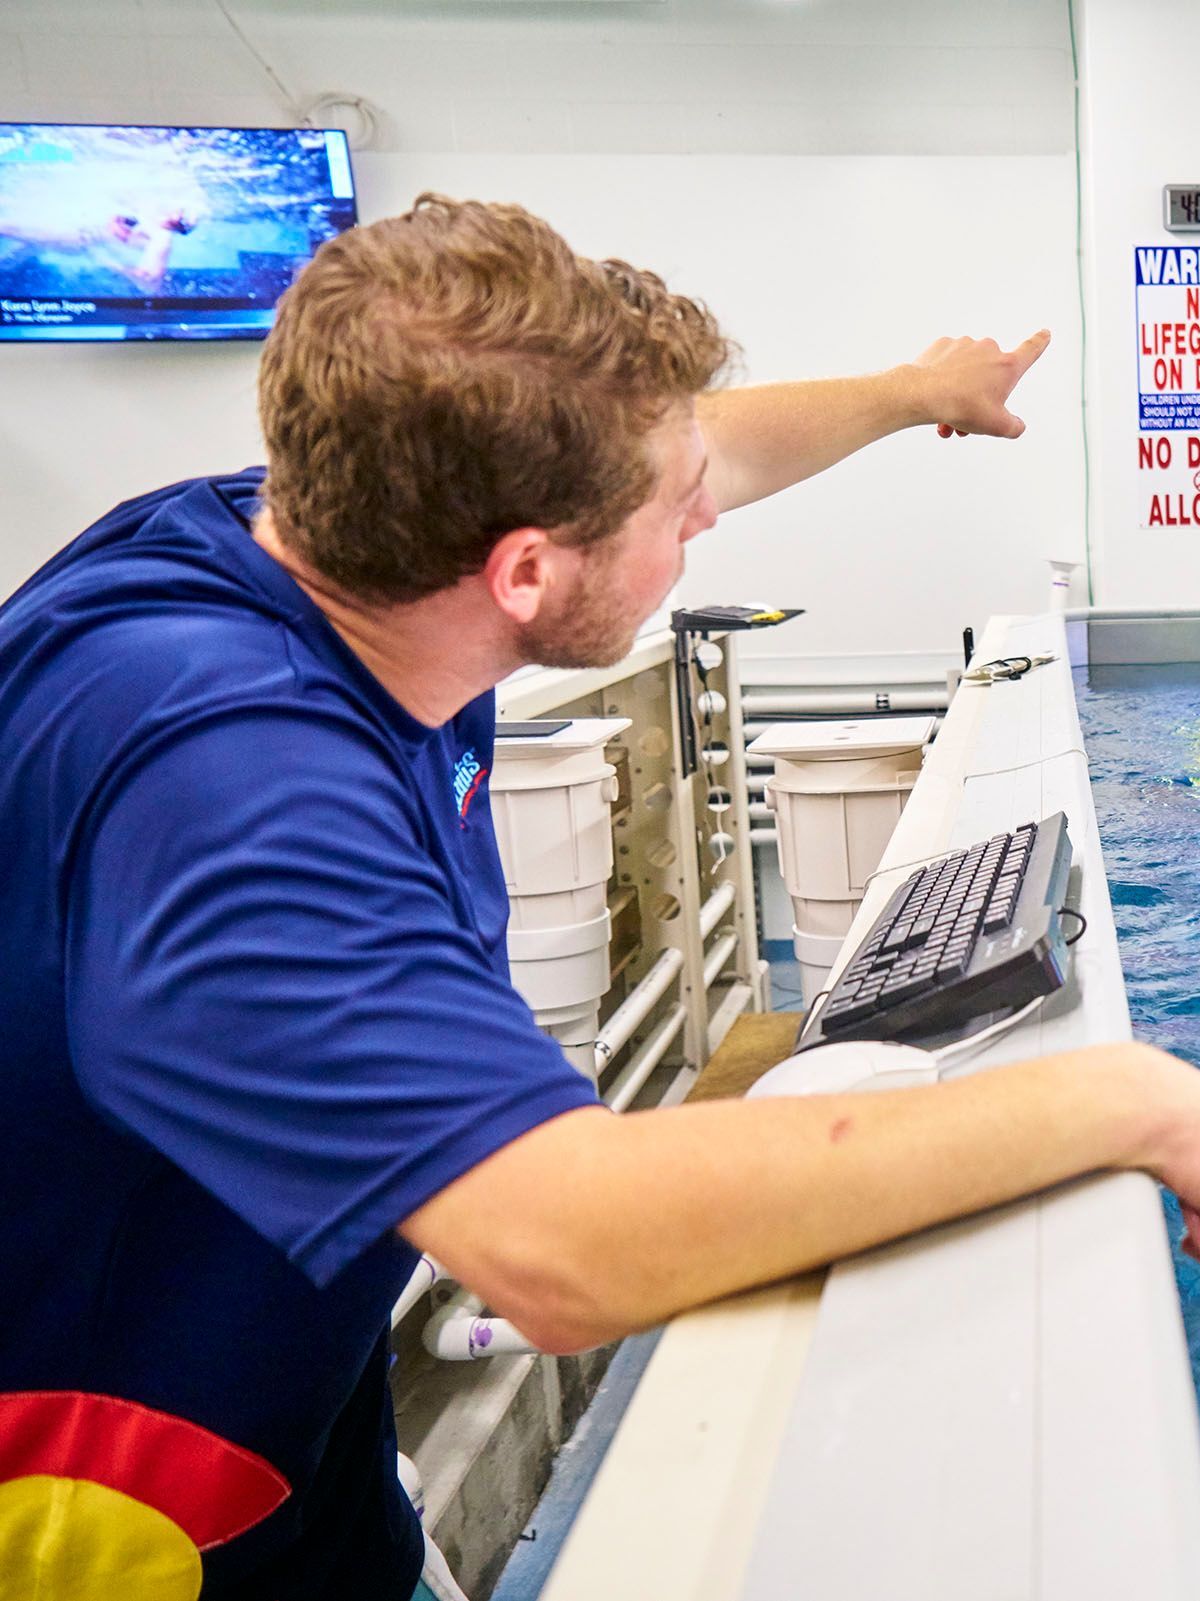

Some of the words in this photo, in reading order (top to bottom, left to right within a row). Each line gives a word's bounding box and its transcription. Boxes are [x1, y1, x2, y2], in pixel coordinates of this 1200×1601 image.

[1154, 358, 1183, 391] ON
[1141, 395, 1180, 405] CHILDREN
[1144, 406, 1175, 417] SHOULD
[1177, 406, 1193, 416] NOT
[1140, 418, 1173, 428] WITHOUT
[1174, 418, 1185, 428] AN
[1138, 437, 1172, 469] NO
